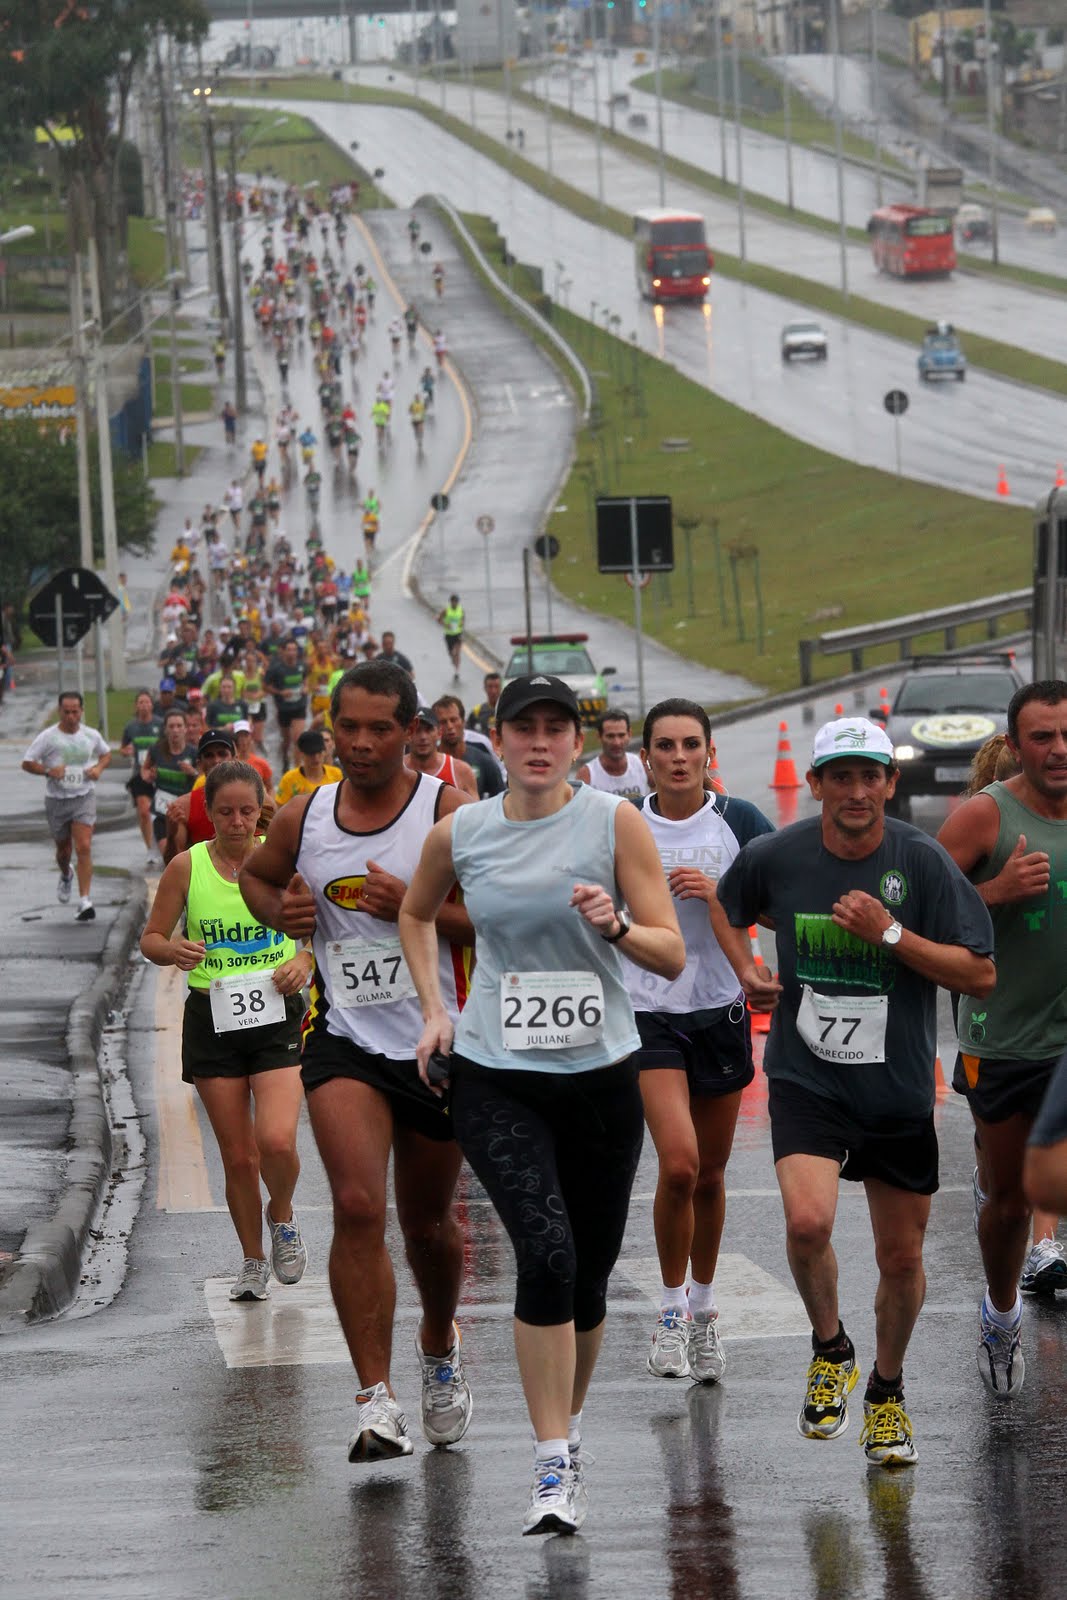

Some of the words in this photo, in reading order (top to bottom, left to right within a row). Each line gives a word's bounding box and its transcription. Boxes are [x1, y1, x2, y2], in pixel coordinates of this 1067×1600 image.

[200, 918, 222, 926] EQUIPE
[204, 958, 223, 970] (41)
[341, 955, 402, 990] 547
[229, 989, 266, 1017] 38
[356, 991, 393, 1003] GILMAR
[504, 994, 602, 1028] 2266
[238, 1016, 260, 1027] VERA
[818, 1015, 862, 1046] 77
[526, 1034, 571, 1045] JULIANE
